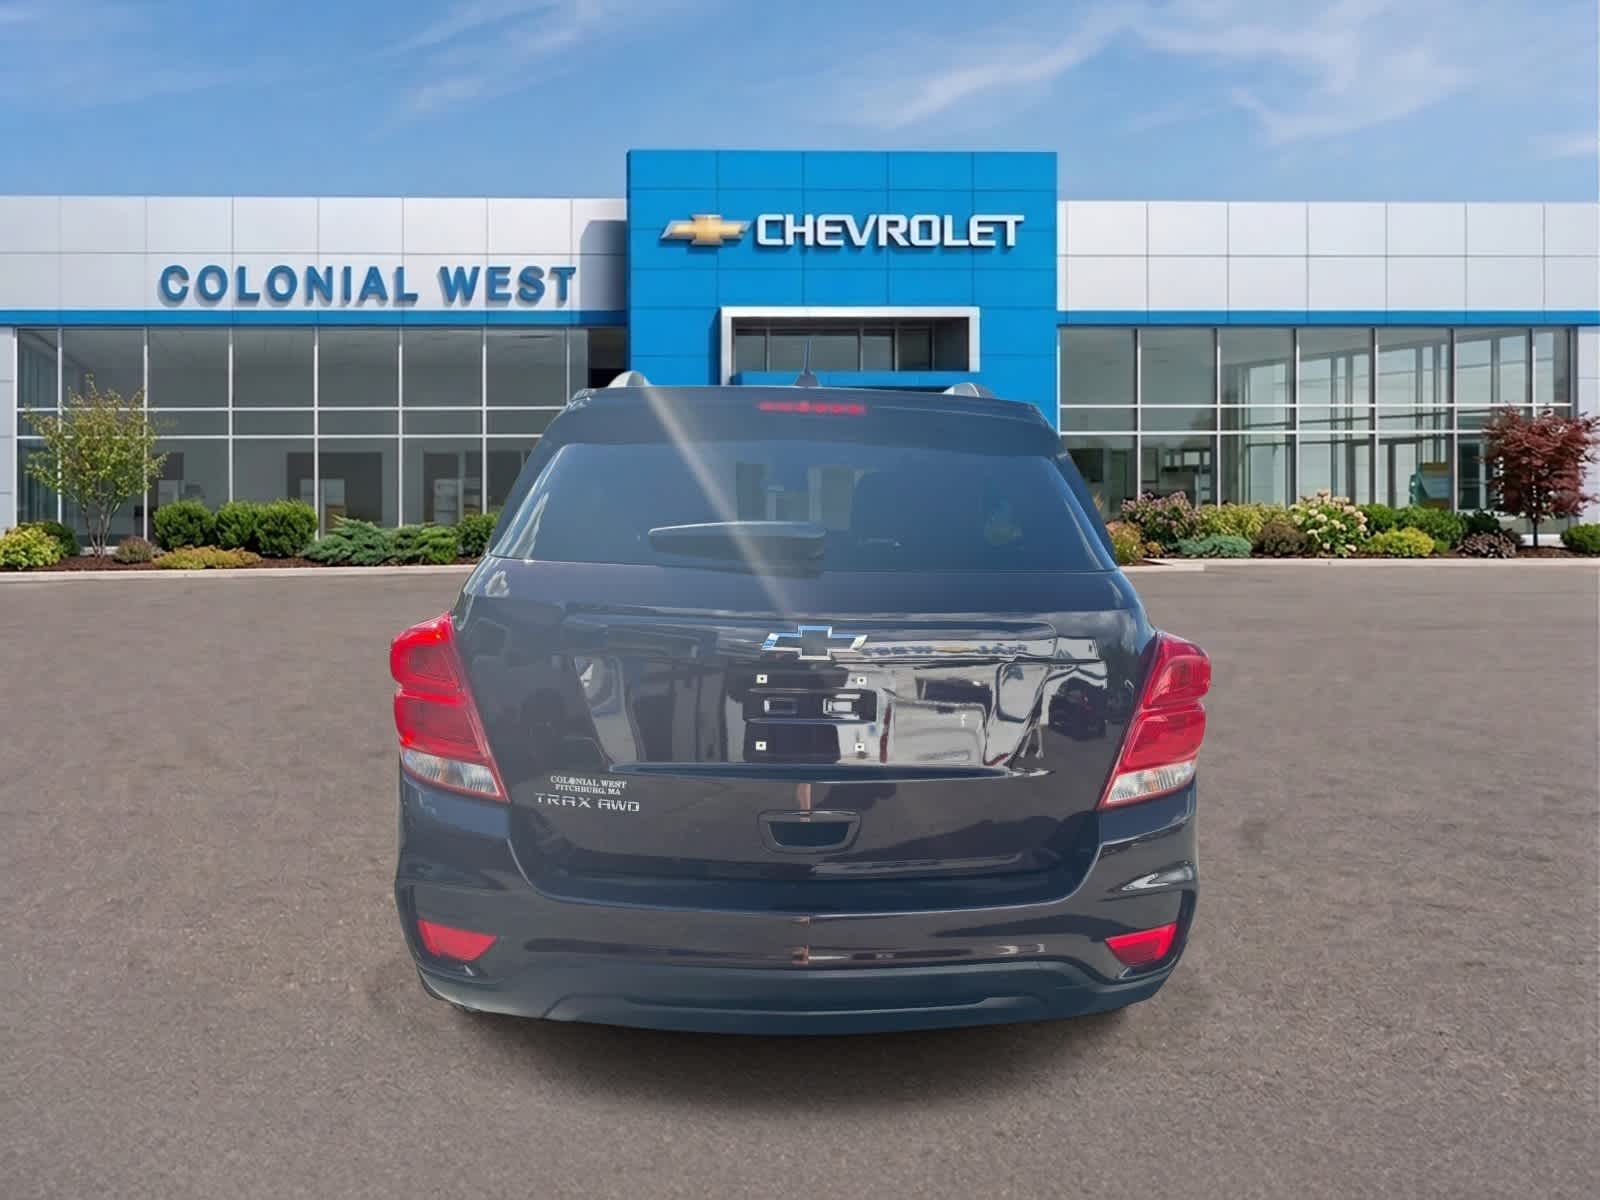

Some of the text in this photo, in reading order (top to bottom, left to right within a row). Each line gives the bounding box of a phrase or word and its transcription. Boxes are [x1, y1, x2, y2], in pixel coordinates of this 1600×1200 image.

[756, 213, 1025, 247] CHEVROLET
[158, 264, 577, 304] COLONIAL WEST
[550, 775, 627, 789] COLONIAL WEST
[608, 787, 621, 796] MA
[535, 792, 640, 812] TRAX AWD
